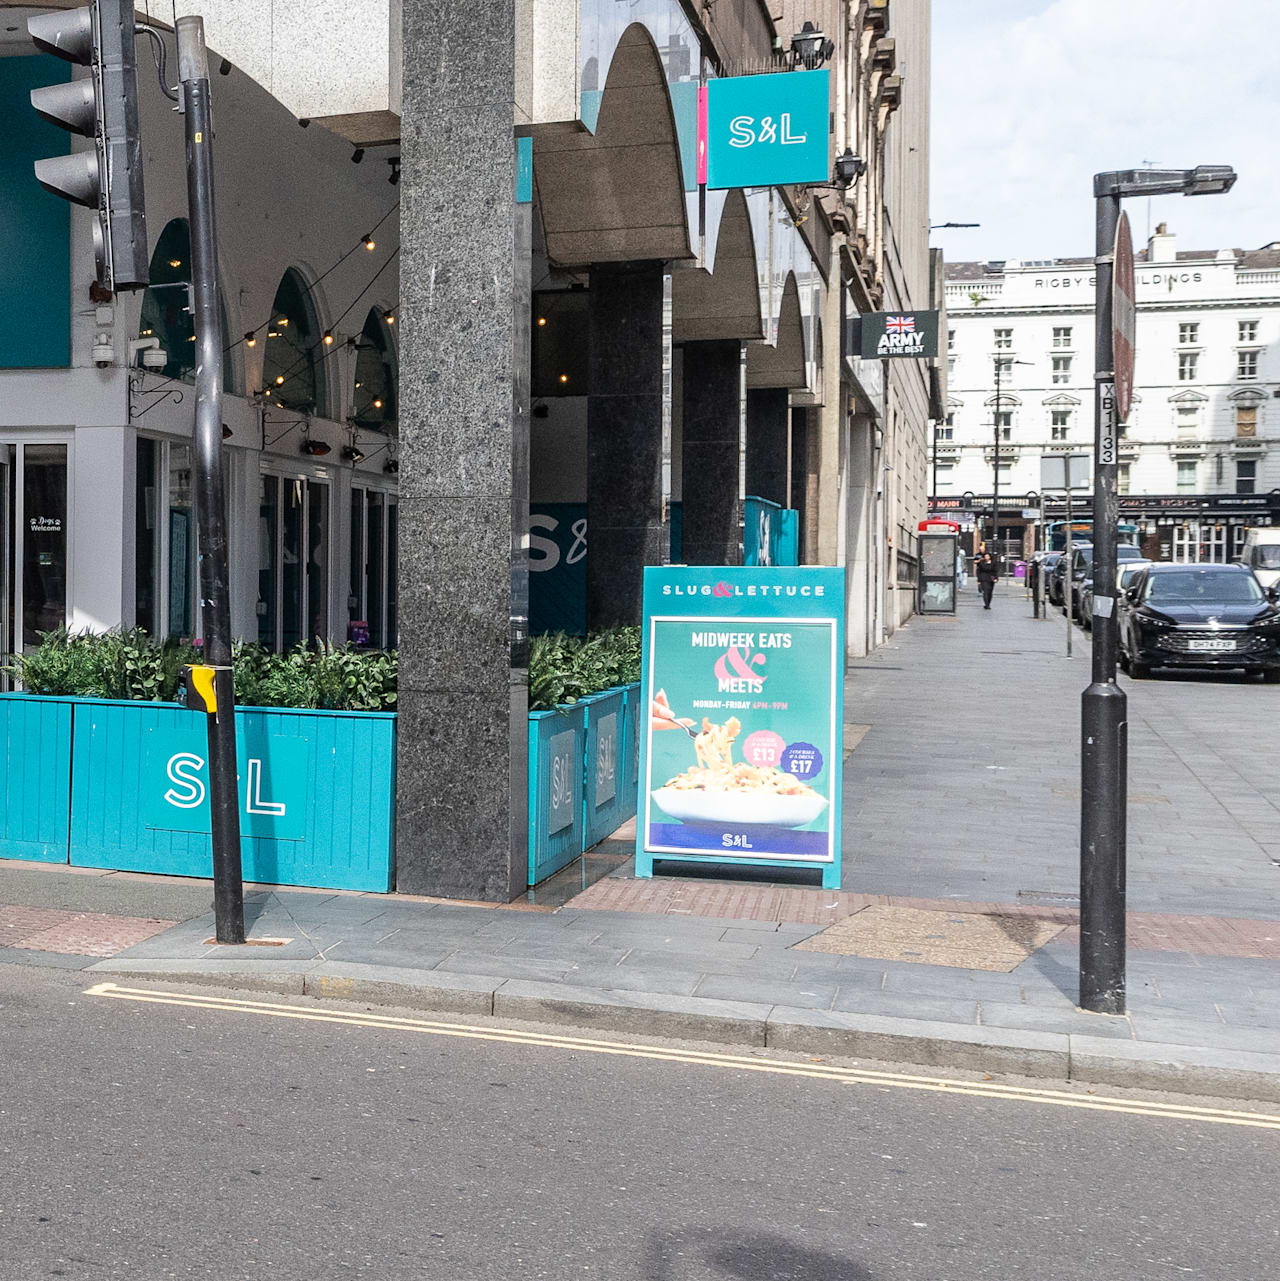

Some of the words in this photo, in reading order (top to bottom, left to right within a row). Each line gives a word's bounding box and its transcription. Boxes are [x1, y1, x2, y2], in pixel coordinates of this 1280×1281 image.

[729, 113, 807, 148] S&L
[1136, 273, 1203, 285] ILDINGS
[878, 331, 925, 348] ARMY
[877, 346, 888, 355] BE
[889, 346, 904, 354] THE
[905, 345, 925, 353] BEST
[31, 524, 61, 532] Welcome
[529, 514, 588, 572] S&
[691, 632, 755, 648] MIDWEEK
[758, 632, 793, 648] EATS
[714, 646, 769, 685] &
[718, 678, 763, 694] MEETS
[693, 699, 750, 710] MONDAY-FRIDAY
[753, 747, 775, 761] £13
[790, 759, 813, 773] £17
[164, 752, 287, 817] SL
[721, 833, 753, 849] S&L
